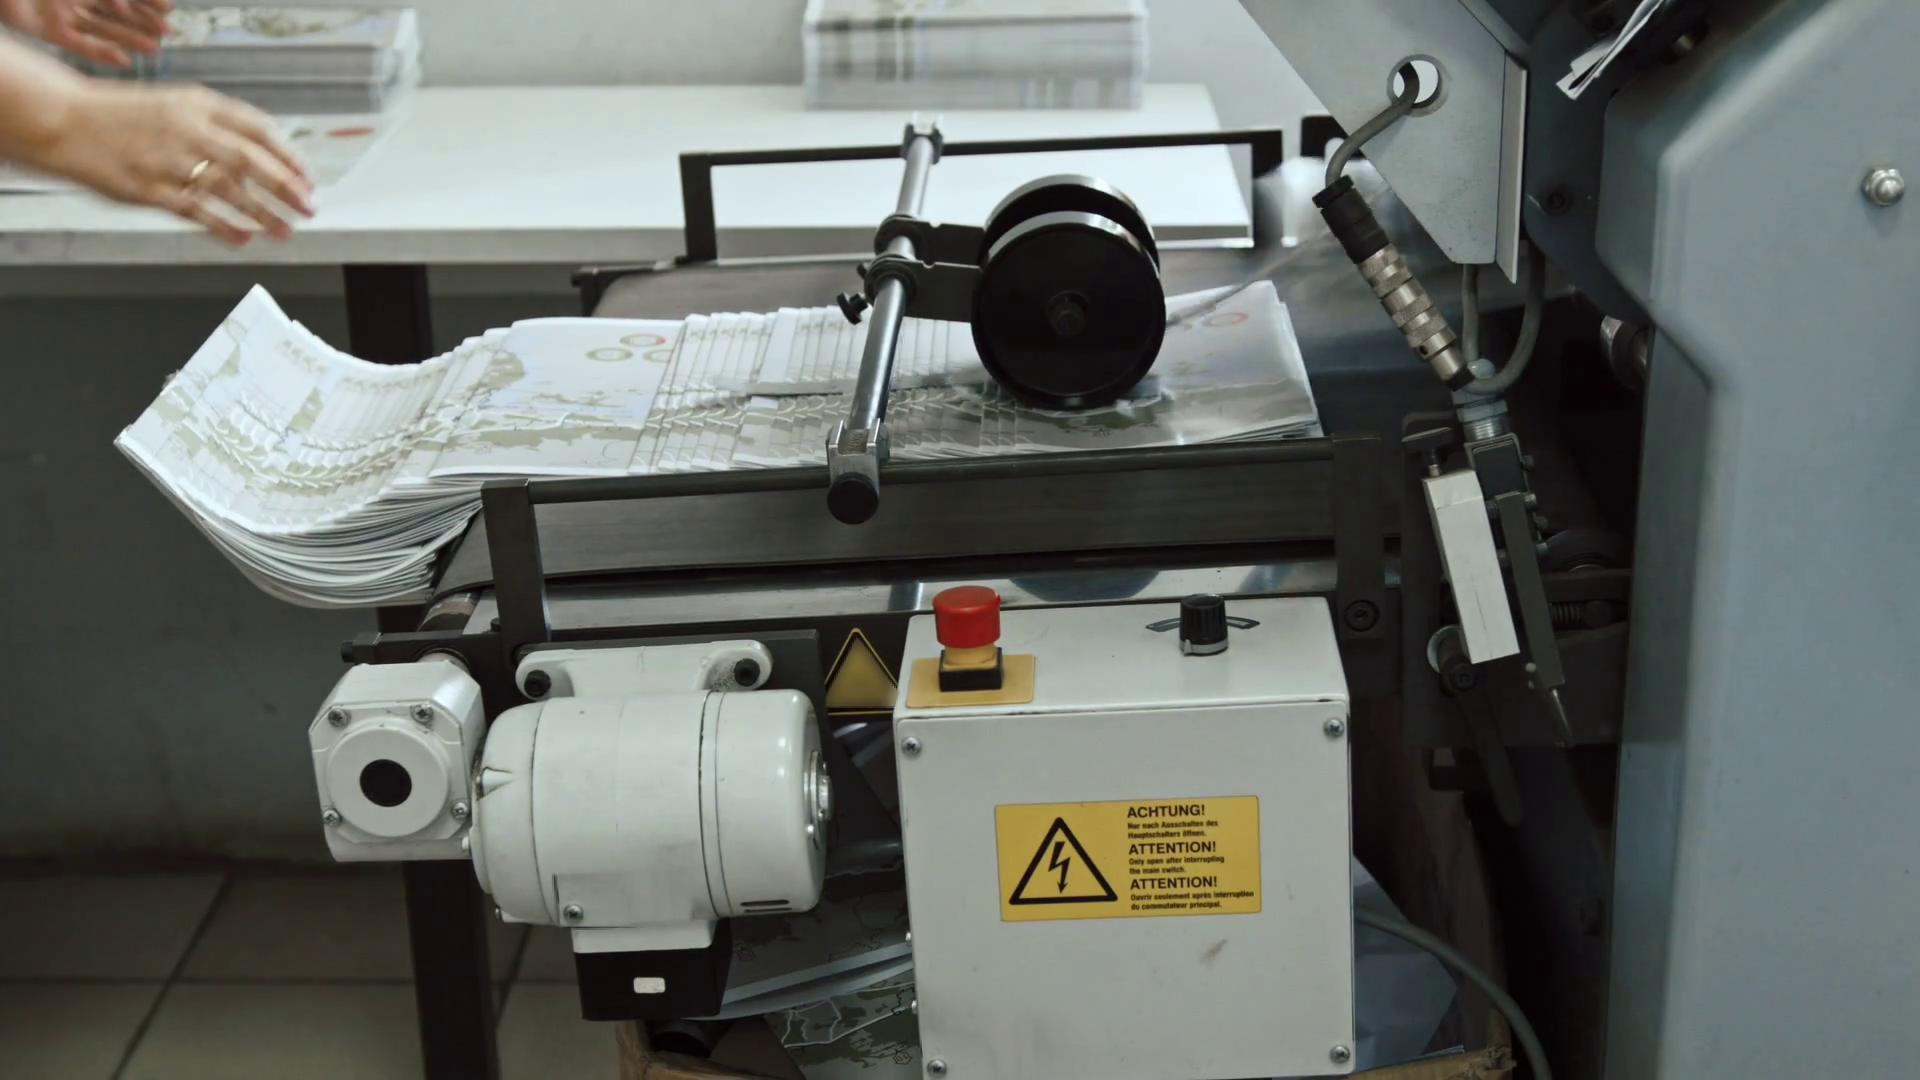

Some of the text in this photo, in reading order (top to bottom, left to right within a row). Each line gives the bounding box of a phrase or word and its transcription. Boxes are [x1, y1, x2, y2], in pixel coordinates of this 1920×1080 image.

[1128, 804, 1205, 818] ACHTUNG!
[1129, 841, 1216, 855] ATTENTION!
[1130, 876, 1217, 890] ATTENTION!
[1190, 901, 1222, 909] principal.
